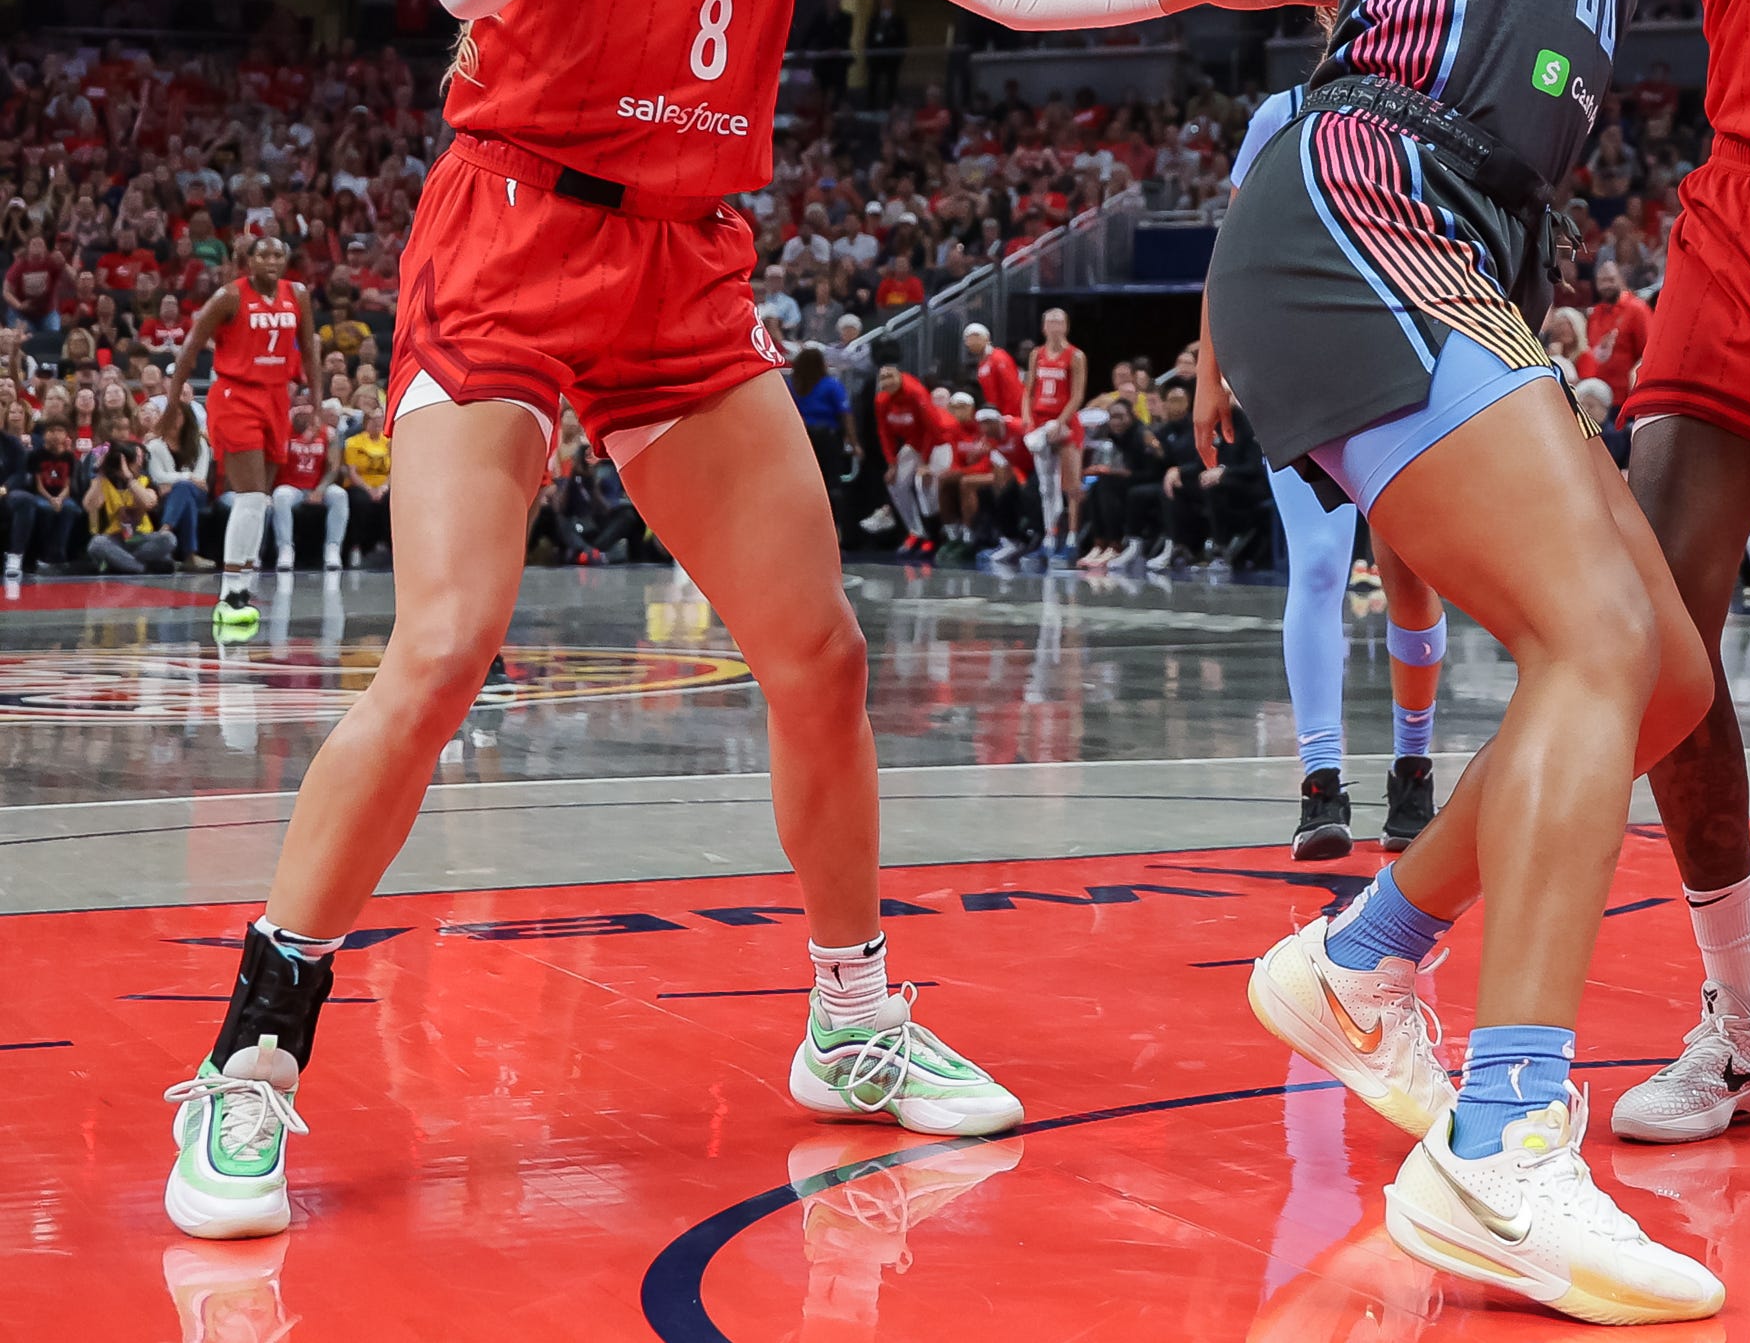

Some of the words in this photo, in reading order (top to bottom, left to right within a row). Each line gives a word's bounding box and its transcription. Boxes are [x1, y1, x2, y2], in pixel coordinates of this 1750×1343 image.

[615, 94, 750, 137] salesforce
[249, 311, 298, 330] FEVER
[267, 329, 280, 354] 7
